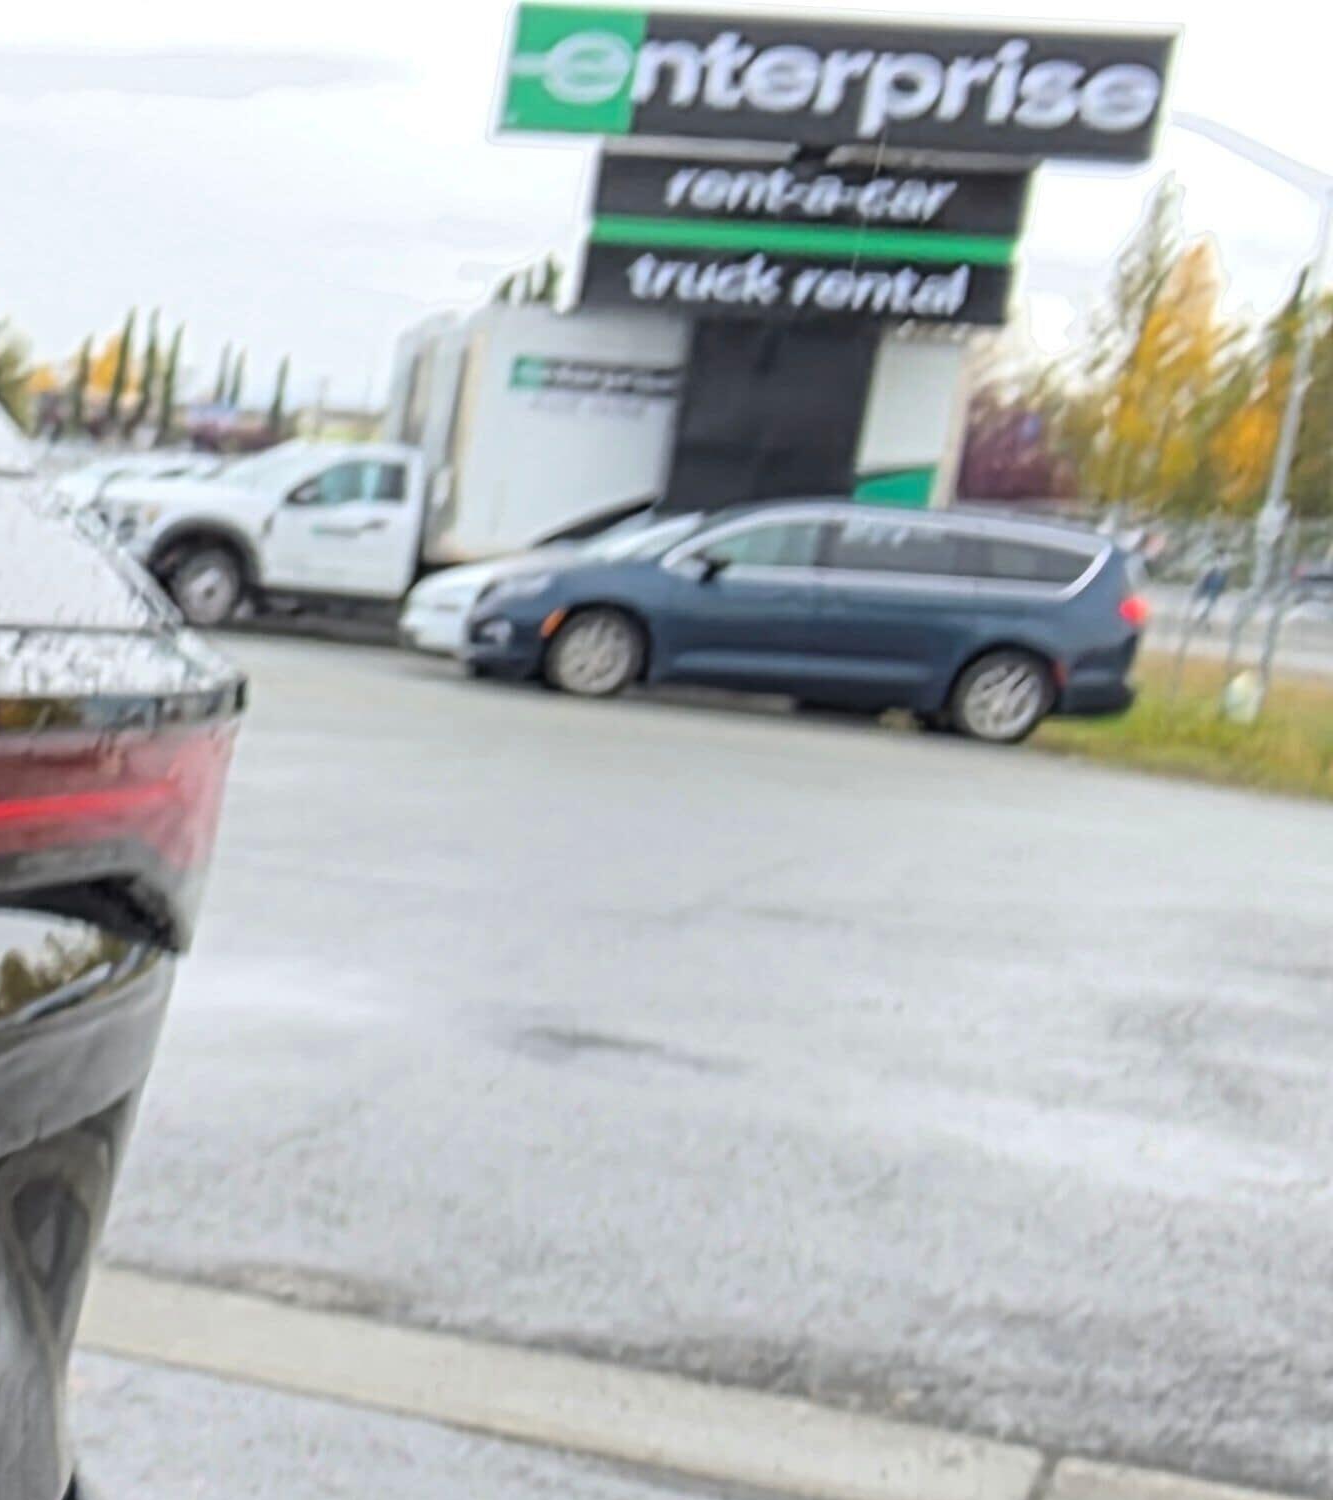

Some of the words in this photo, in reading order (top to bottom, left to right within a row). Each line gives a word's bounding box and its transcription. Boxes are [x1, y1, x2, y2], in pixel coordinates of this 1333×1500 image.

[511, 28, 1163, 138] enterprise
[664, 164, 958, 222] rent-a-car
[626, 250, 782, 304] truck
[791, 263, 971, 317] rental
